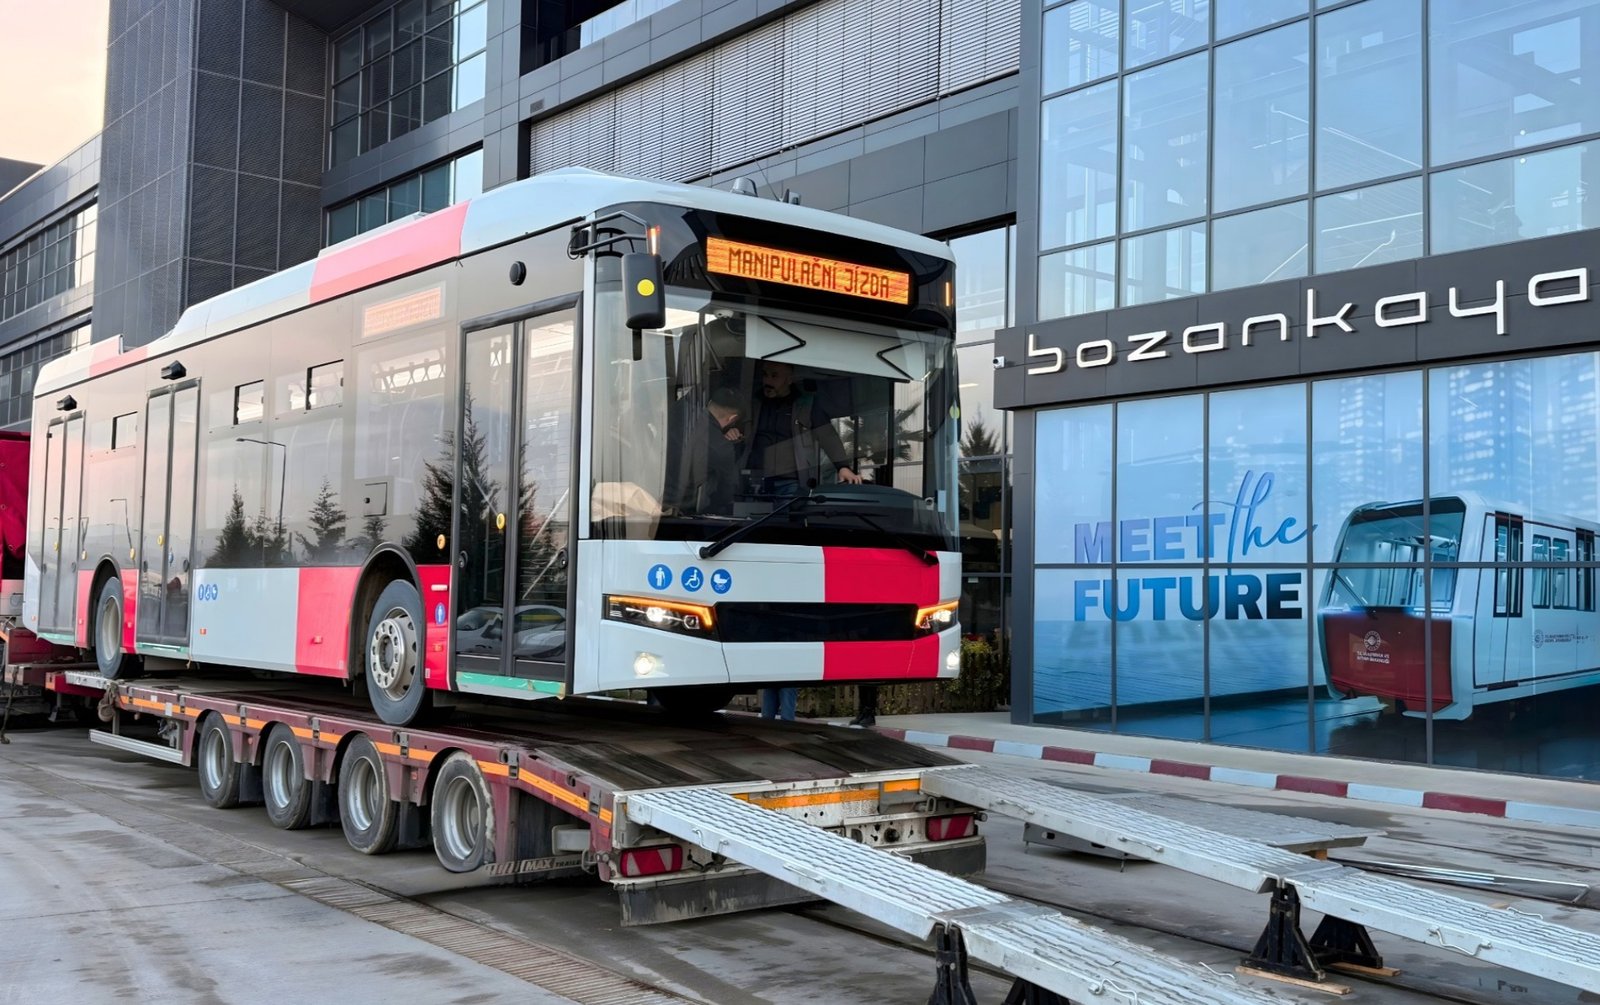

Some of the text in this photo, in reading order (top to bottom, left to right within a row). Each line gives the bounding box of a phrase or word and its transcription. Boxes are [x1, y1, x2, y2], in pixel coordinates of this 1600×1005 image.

[728, 247, 890, 299] MANIPULAČNÍ JÍZDA
[1027, 267, 1588, 376] bozankaya
[1074, 470, 1318, 576] MEET the
[1074, 572, 1303, 622] FUTURE
